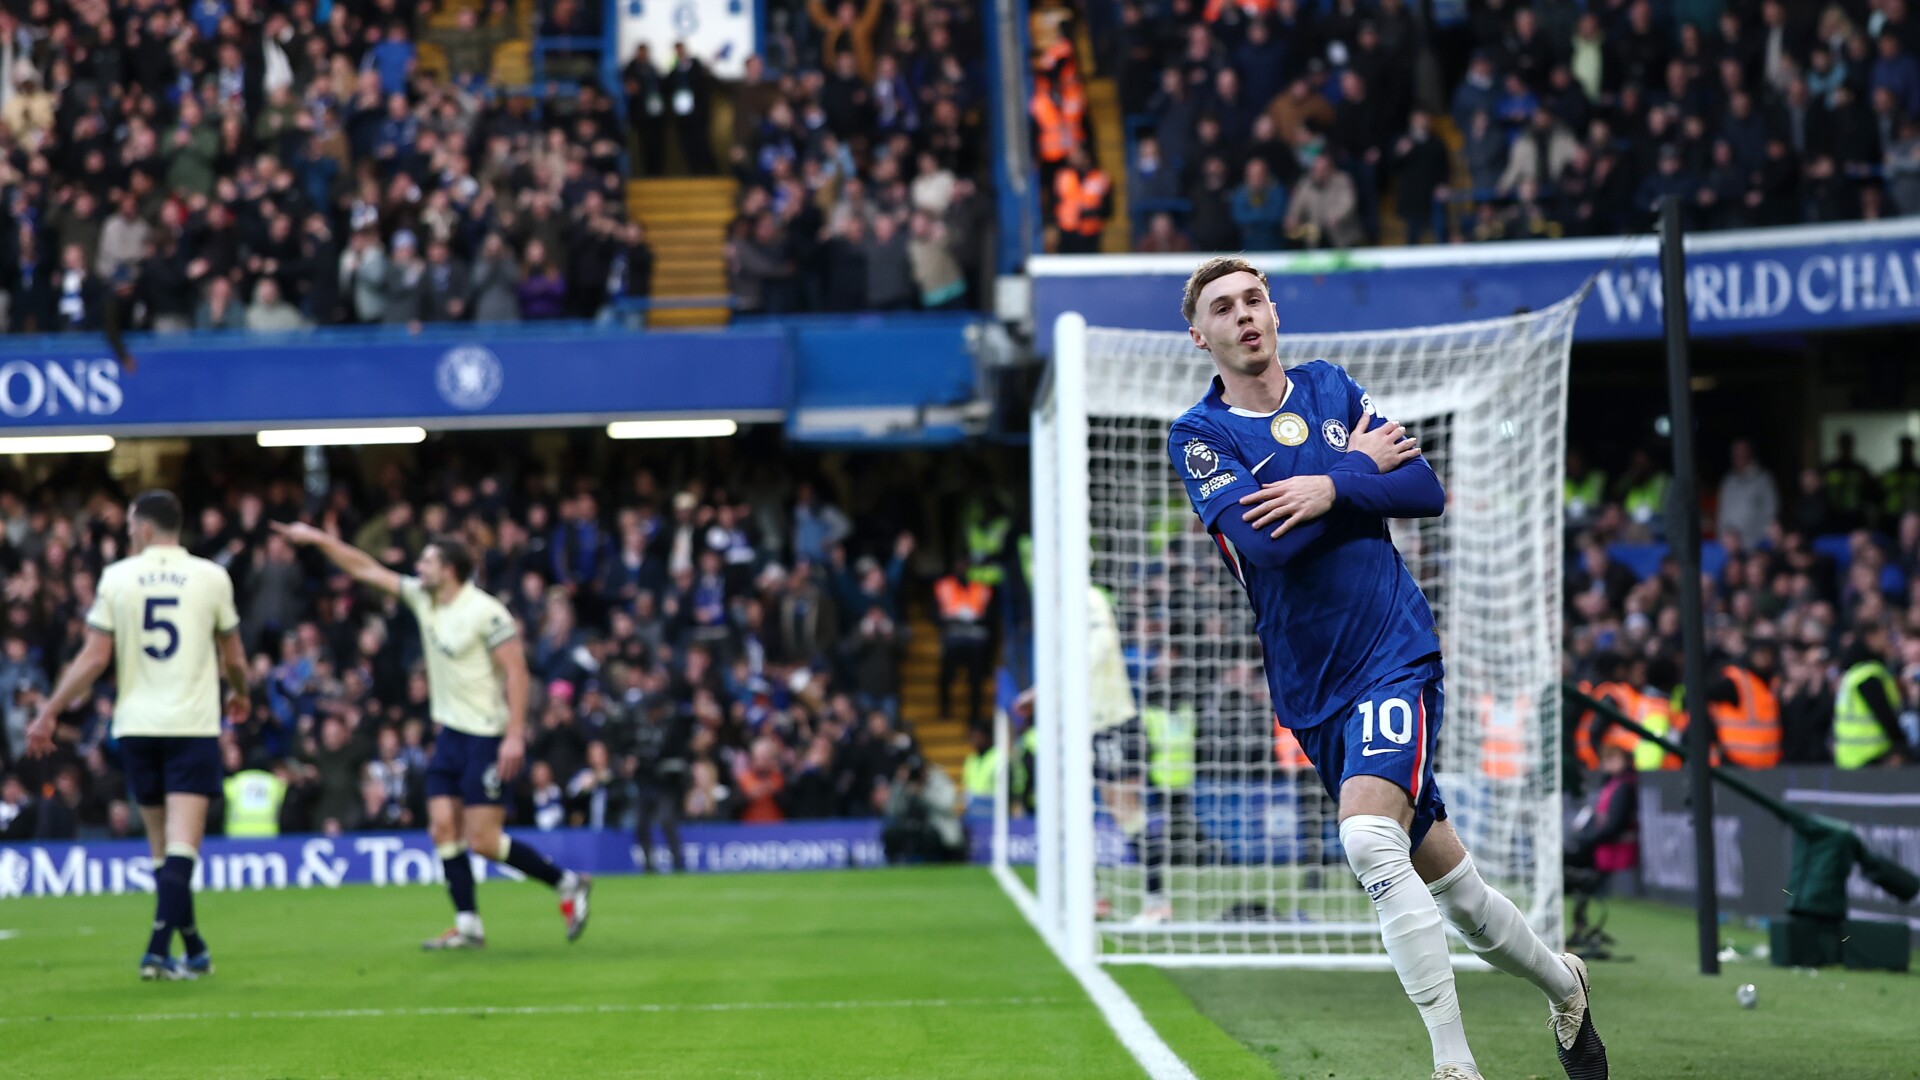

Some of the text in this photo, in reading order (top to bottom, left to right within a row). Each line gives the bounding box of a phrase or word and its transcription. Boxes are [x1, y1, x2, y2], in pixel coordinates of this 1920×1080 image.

[1209, 473, 1231, 486] room
[1210, 475, 1238, 491] racism
[143, 597, 179, 662] 5
[1358, 698, 1413, 744] 10
[31, 845, 288, 897] Musum
[297, 838, 349, 888] &
[706, 839, 848, 872] LONDON'S
